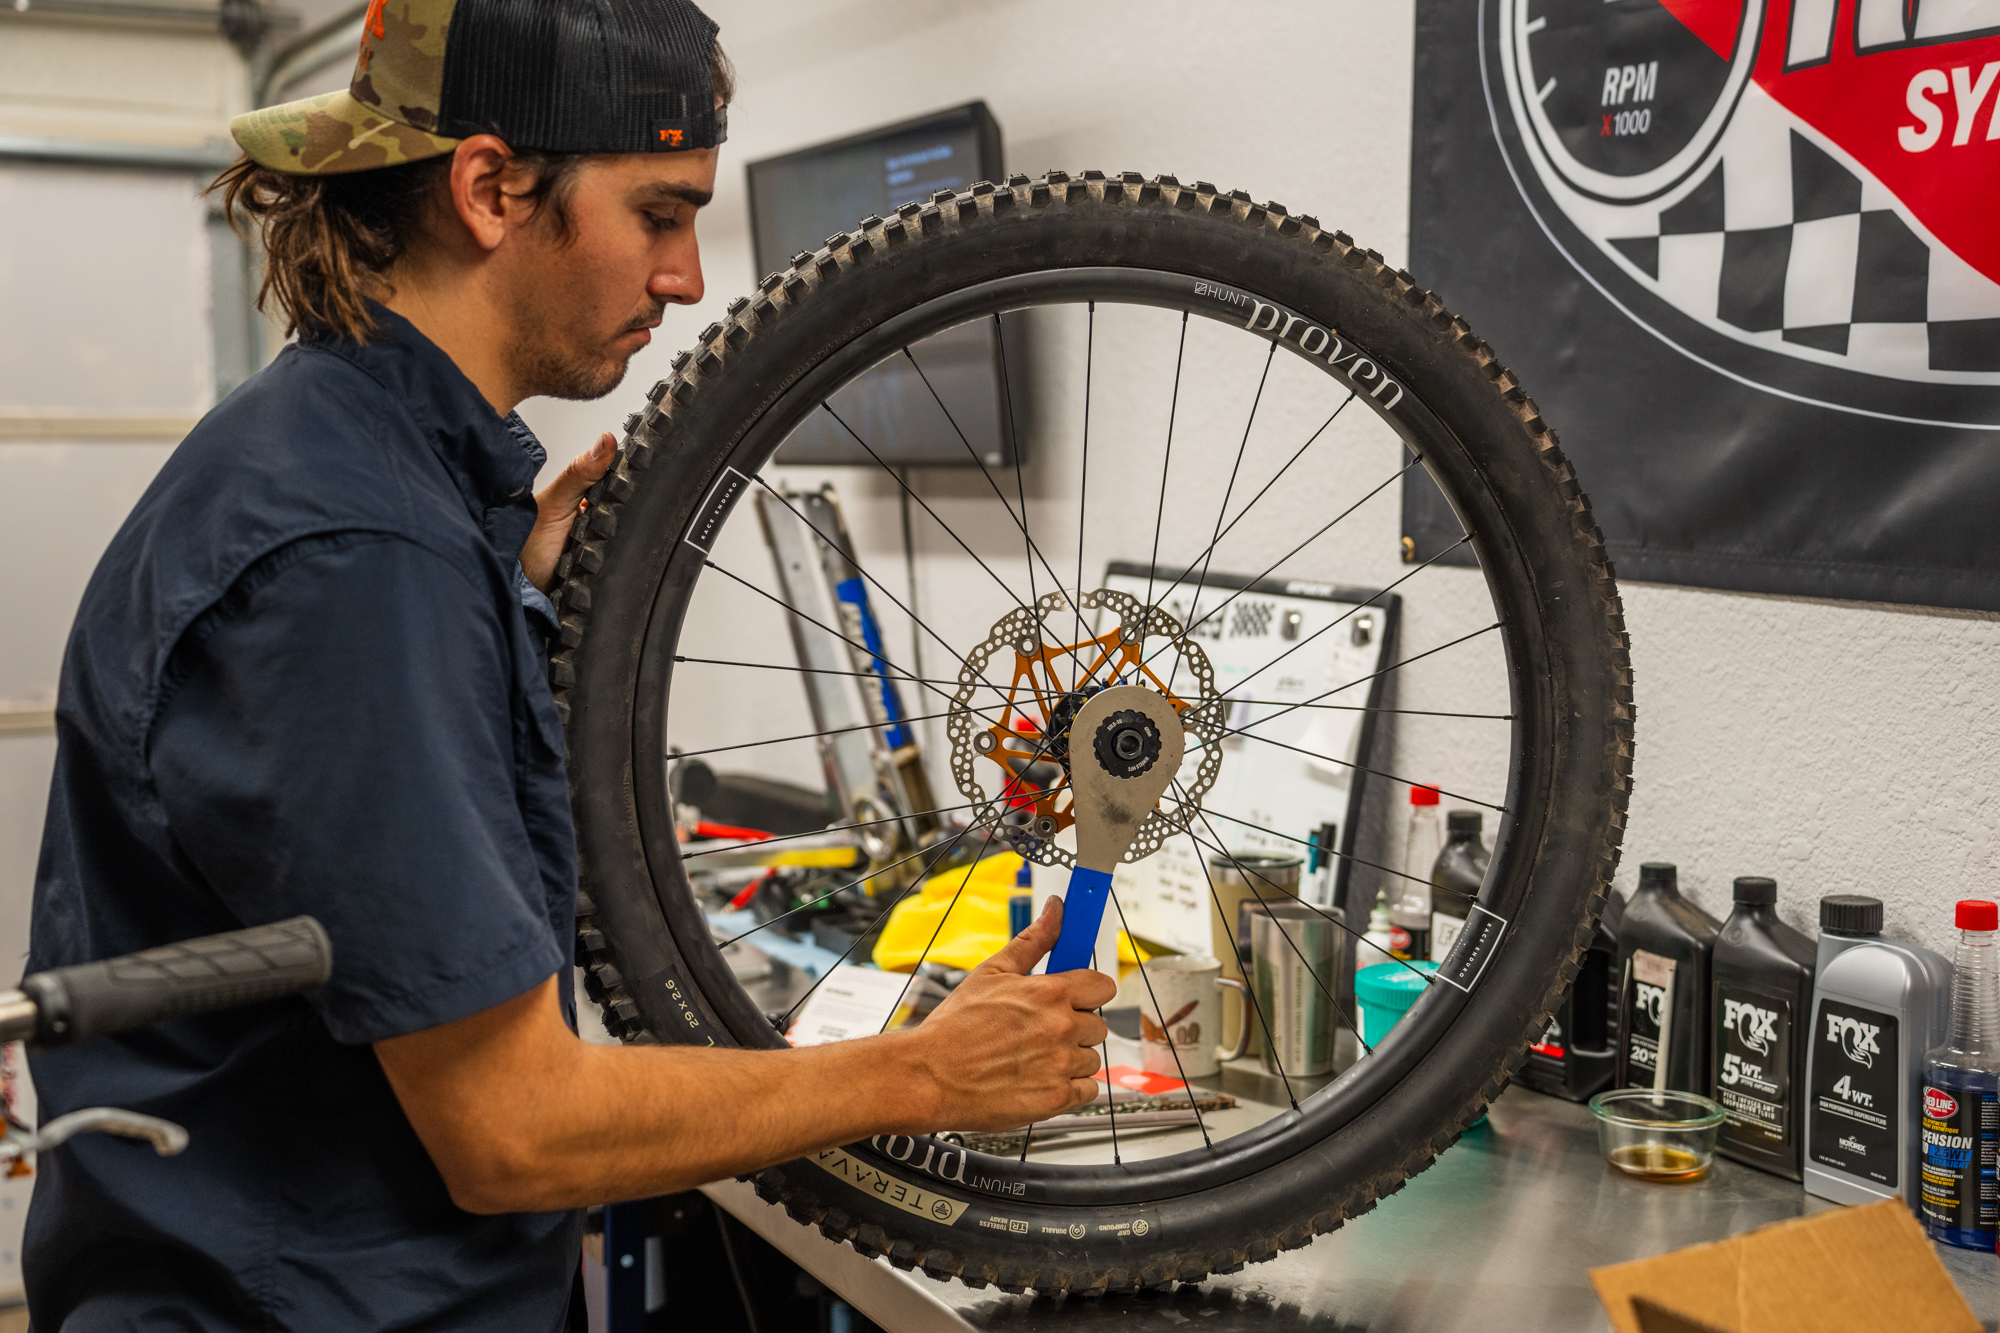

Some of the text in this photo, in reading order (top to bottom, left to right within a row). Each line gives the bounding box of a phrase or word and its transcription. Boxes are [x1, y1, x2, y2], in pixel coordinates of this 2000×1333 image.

[1601, 61, 1658, 107] RPM
[1898, 61, 2000, 153] SY
[659, 129, 683, 147] FOX
[1207, 285, 1403, 411] HUNT proven
[701, 482, 737, 540] RACE ENDURO
[1459, 922, 1492, 978] RACE ENDURO
[665, 979, 699, 1029] 29 x 2.6
[1636, 983, 1666, 1027] FO
[1723, 998, 1778, 1058] FOX
[1630, 1045, 1658, 1063] 20 W
[1826, 1013, 1880, 1070] FOX
[1720, 1052, 1762, 1085] 5 WT.
[1832, 1074, 1873, 1107] 4 WT.
[1925, 1095, 1954, 1110] RED LINE
[1819, 1100, 1887, 1126] HIGH PERFORMANCE SUSPENSION FLUID
[1839, 1137, 1866, 1152] MOTOREX
[1922, 1128, 1973, 1150] PENSION
[871, 1134, 967, 1184] pro
[1928, 1156, 1970, 1169] EXTRALIGHT
[1933, 1147, 1970, 1161] 2.5WT
[818, 1150, 924, 1210] TERAVA
[969, 1175, 1013, 1195] HUNT
[979, 1220, 1007, 1231] TUBELESS
[1011, 1221, 1026, 1232] TR
[1041, 1227, 1067, 1235] DURABLE
[1098, 1222, 1130, 1231] COMPOUND
[1117, 1229, 1131, 1237] GRIP
